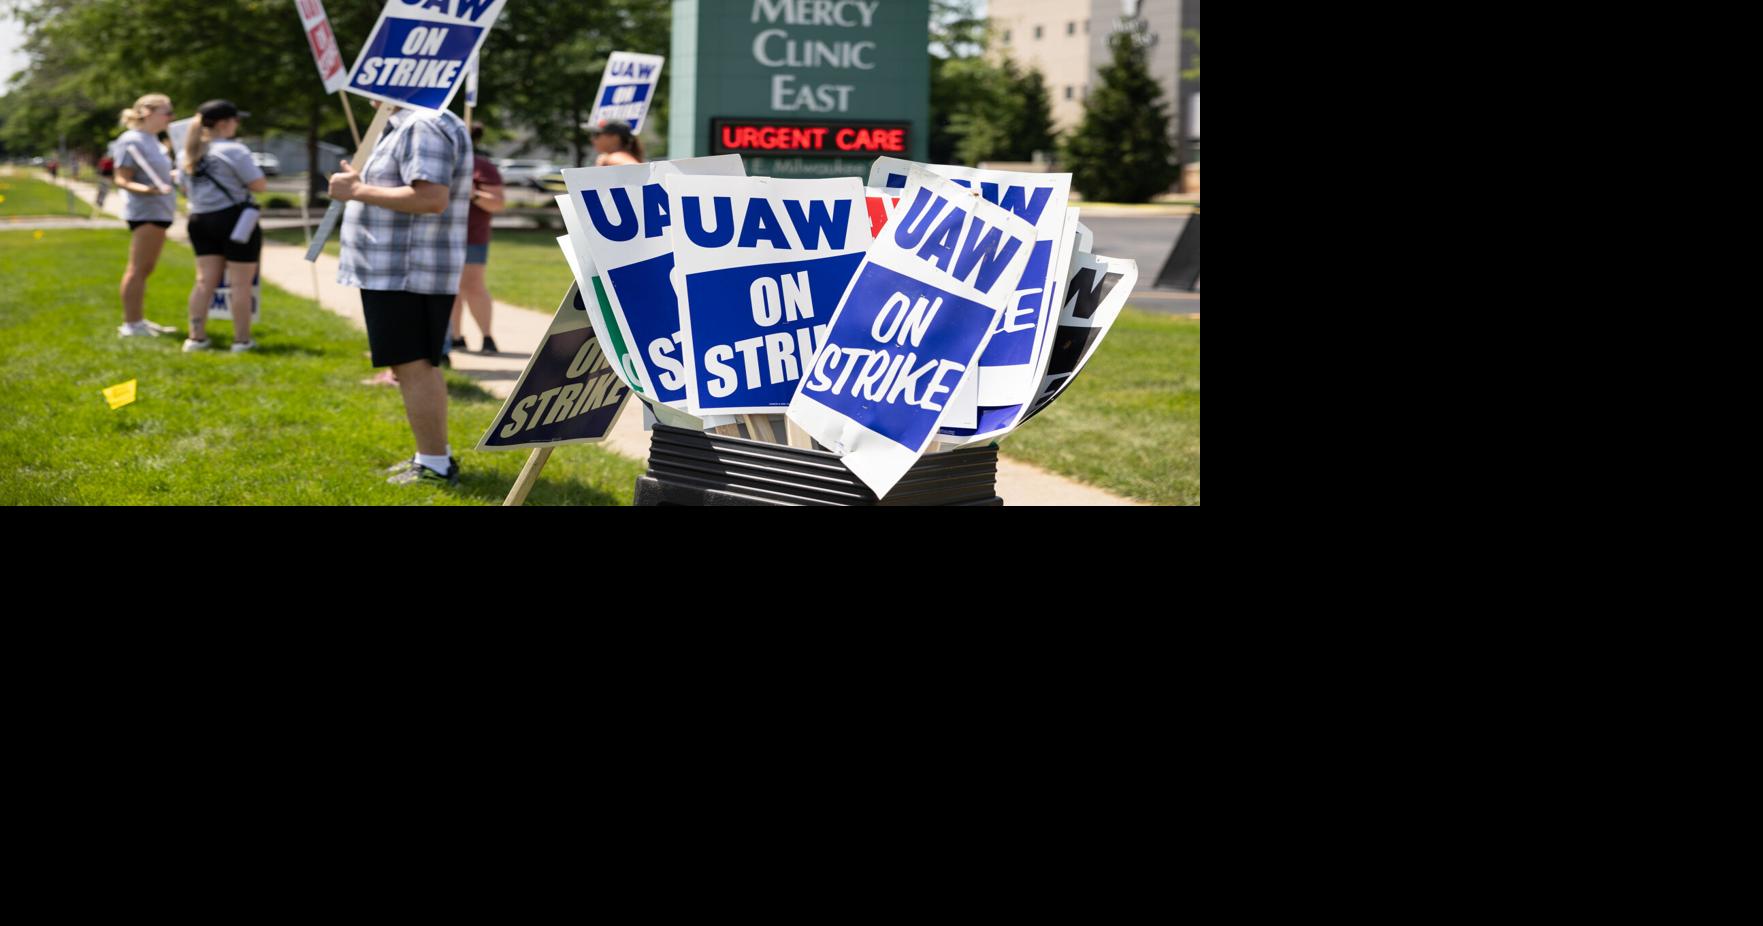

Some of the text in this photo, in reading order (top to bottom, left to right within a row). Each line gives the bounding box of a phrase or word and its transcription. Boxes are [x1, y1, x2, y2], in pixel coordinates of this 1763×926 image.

[751, 0, 878, 26] MERCY
[401, 26, 449, 56] ON
[753, 29, 876, 70] CLINIC
[356, 56, 462, 88] STRIKE
[611, 62, 656, 79] UAW
[771, 74, 853, 112] EAST
[722, 126, 905, 151] URGENT CARE
[681, 196, 852, 250] UAW
[895, 186, 1023, 295] UAW
[749, 270, 815, 327] ON
[871, 291, 943, 348] ON
[704, 324, 827, 398] STRI
[806, 343, 966, 412] STRIKE
[500, 372, 627, 438] STRIKE
